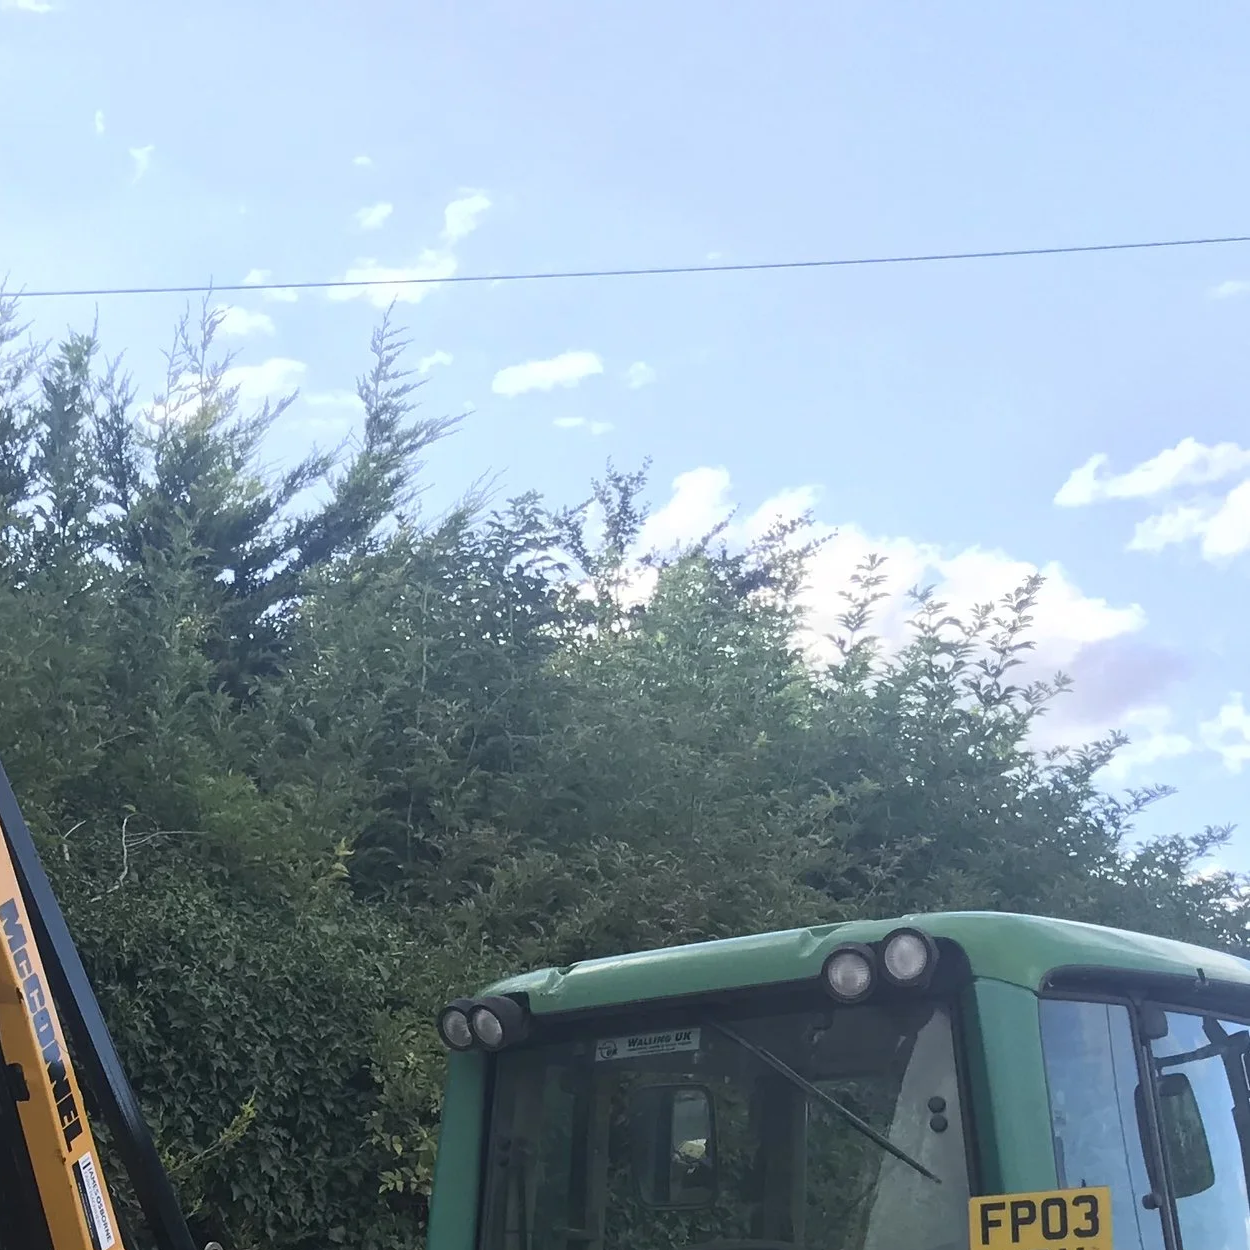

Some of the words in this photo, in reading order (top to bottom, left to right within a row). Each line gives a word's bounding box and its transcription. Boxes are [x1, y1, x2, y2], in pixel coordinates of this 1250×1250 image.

[628, 1034, 672, 1048] WALLING
[675, 1031, 692, 1042] UK
[96, 1196, 112, 1243] OSBORNE
[980, 1194, 1099, 1245] FP03
